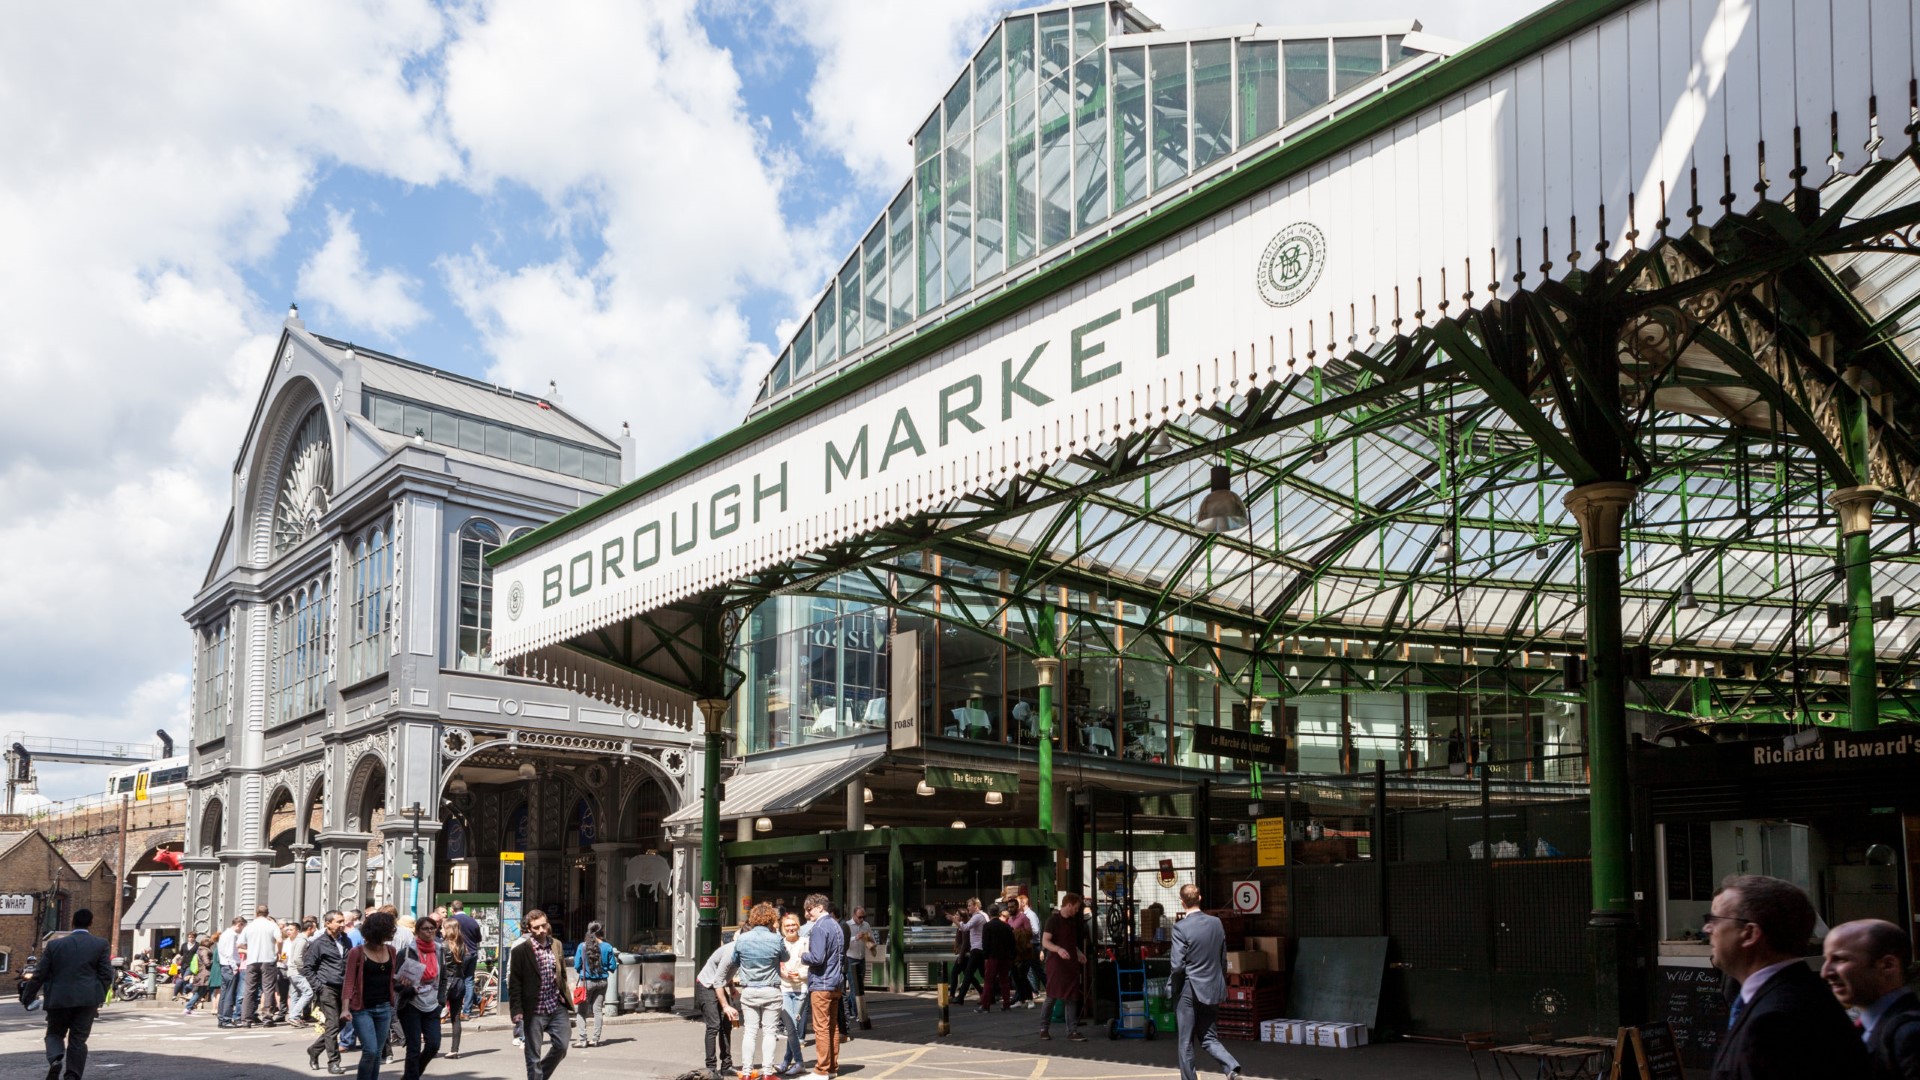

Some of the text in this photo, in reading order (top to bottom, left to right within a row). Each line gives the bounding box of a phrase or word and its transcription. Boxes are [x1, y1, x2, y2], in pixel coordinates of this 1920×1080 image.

[1261, 227, 1322, 287] BOROUGH MARKET
[1281, 289, 1301, 300] 1756
[543, 274, 1195, 609] BOROUGH MARKET
[894, 717, 914, 730] roast
[1211, 734, 1218, 745] Le
[1753, 735, 1920, 765] Richard Haward's
[953, 772, 994, 786] The Ginger Pig
[1243, 891, 1251, 903] 5
[5, 899, 26, 909] WHARF
[1666, 970, 1694, 982] Wild
